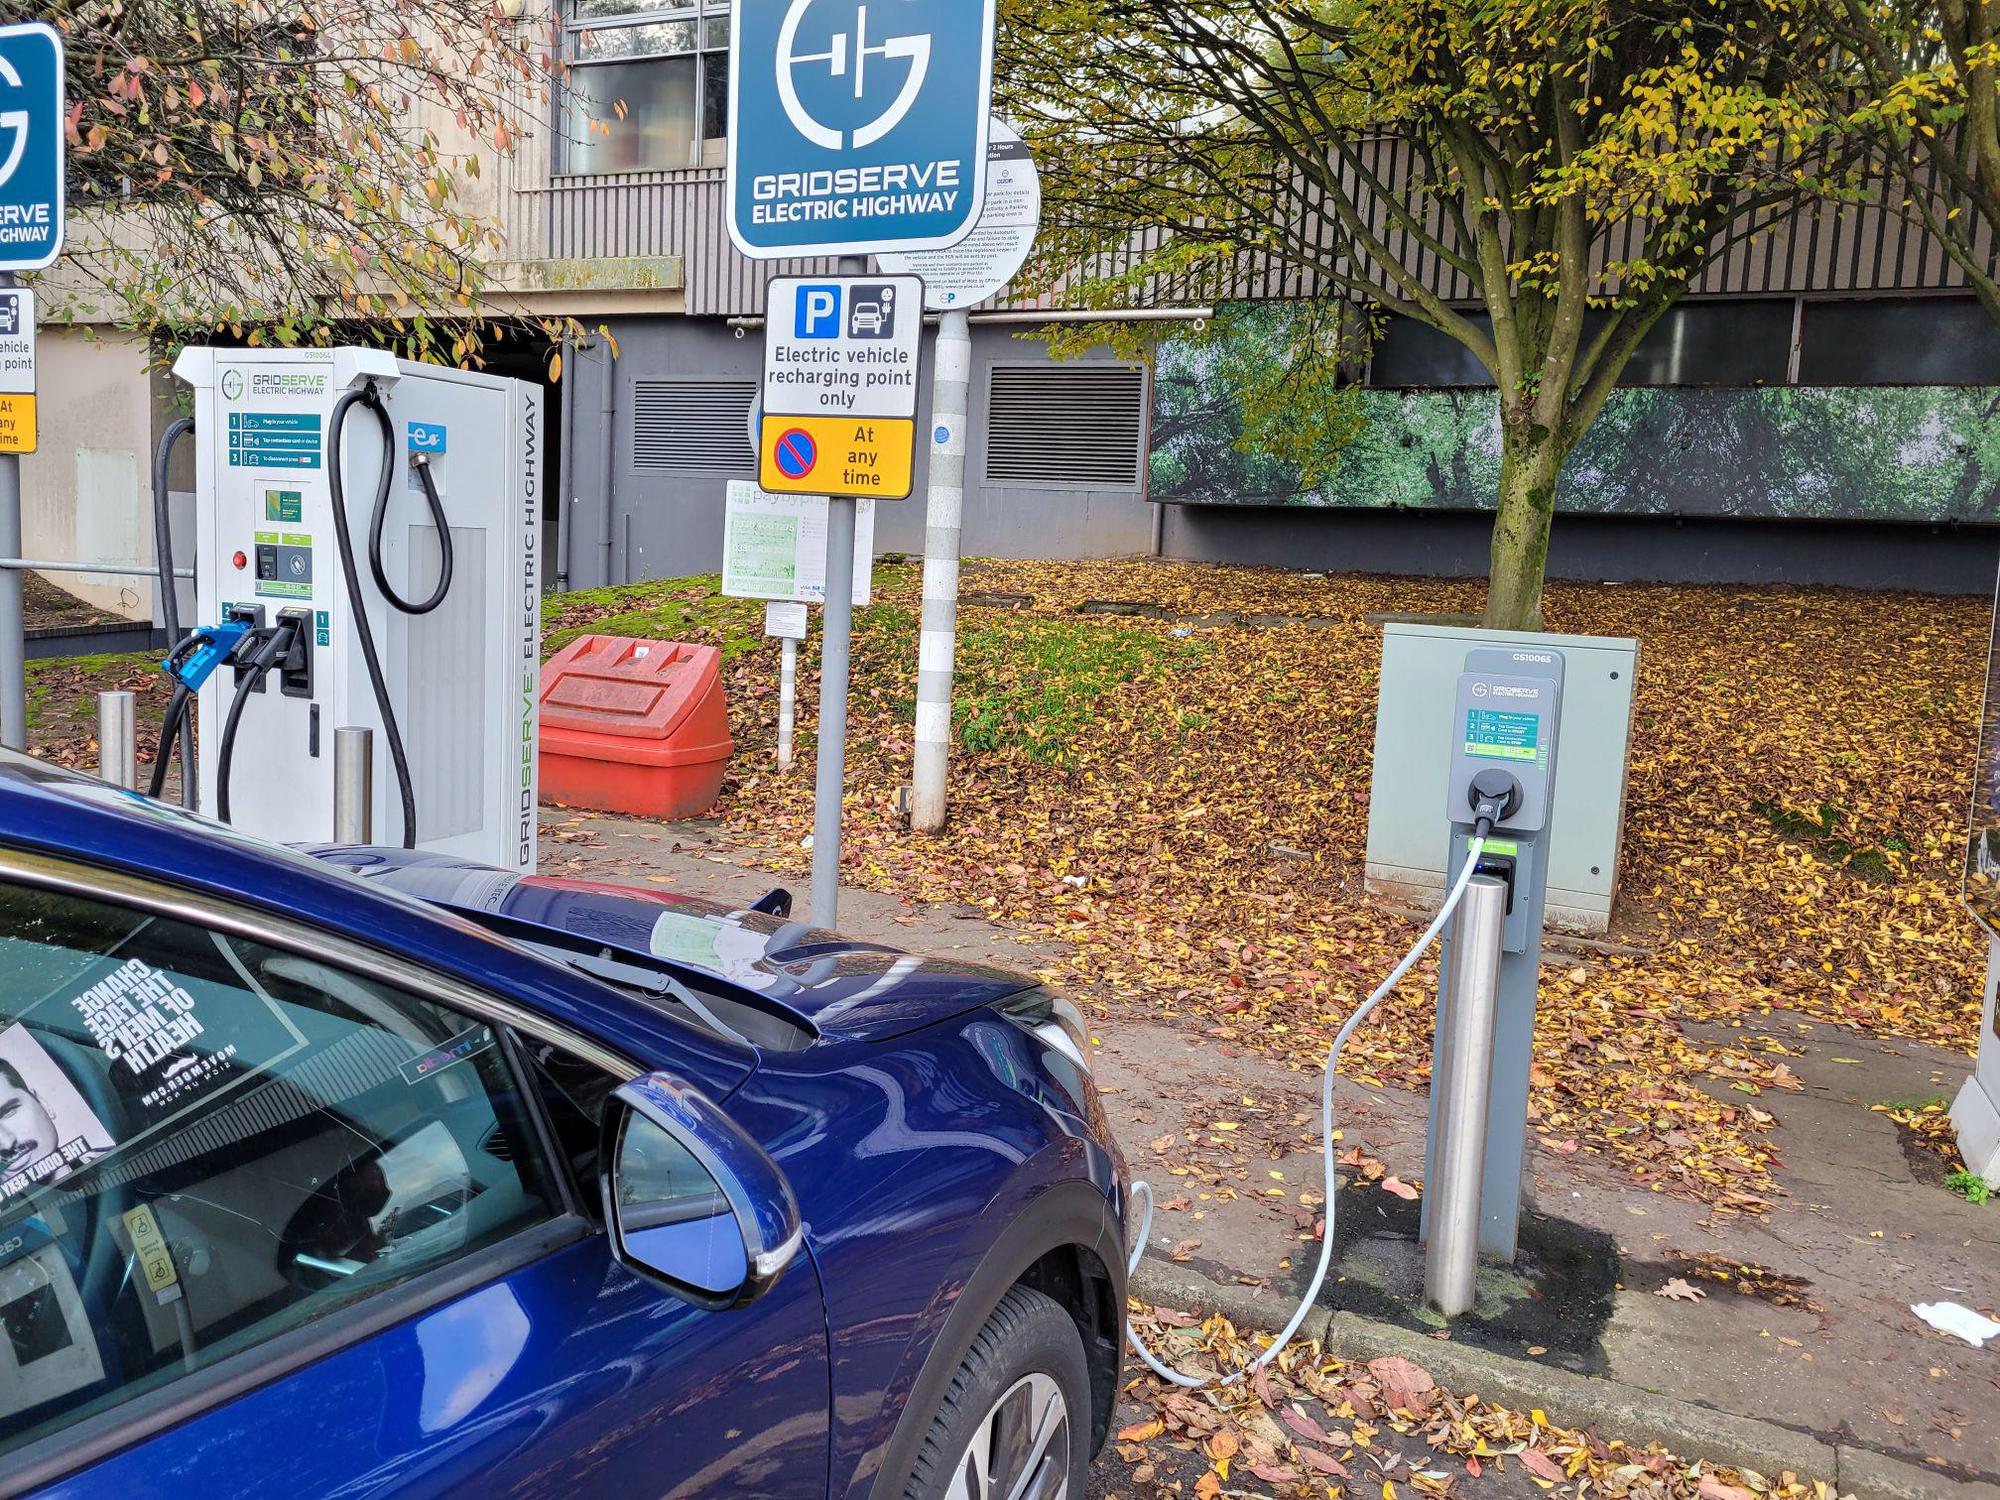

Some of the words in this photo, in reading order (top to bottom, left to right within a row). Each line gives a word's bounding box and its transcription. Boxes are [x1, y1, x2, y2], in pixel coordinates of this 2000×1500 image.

[753, 160, 961, 200] GRIDSERVE
[752, 199, 848, 224] ELECTRIC
[852, 190, 959, 218] HIGHWAY
[805, 291, 835, 335] P
[775, 346, 840, 363] Electric
[846, 348, 908, 364] vehicle
[5, 356, 32, 372] point
[252, 374, 324, 386] GRIDSERVE
[769, 368, 860, 388] recharging
[866, 370, 912, 388] point
[252, 386, 287, 395] ELECTRIC
[288, 387, 325, 395] HIGHWAY
[1, 400, 12, 412] At
[820, 390, 856, 410] only
[232, 417, 236, 425] 1
[232, 436, 237, 444] 2
[854, 426, 874, 443] At
[232, 454, 238, 462] 3
[525, 394, 536, 526] HIGHWAY
[848, 450, 878, 467] any
[843, 469, 881, 486] time
[524, 534, 534, 658] ELECTRIC
[320, 615, 324, 624] 1
[1513, 653, 1552, 663] GS10065
[1493, 686, 1539, 694] GRIDSERVE
[520, 673, 533, 866] GRIDSERVE
